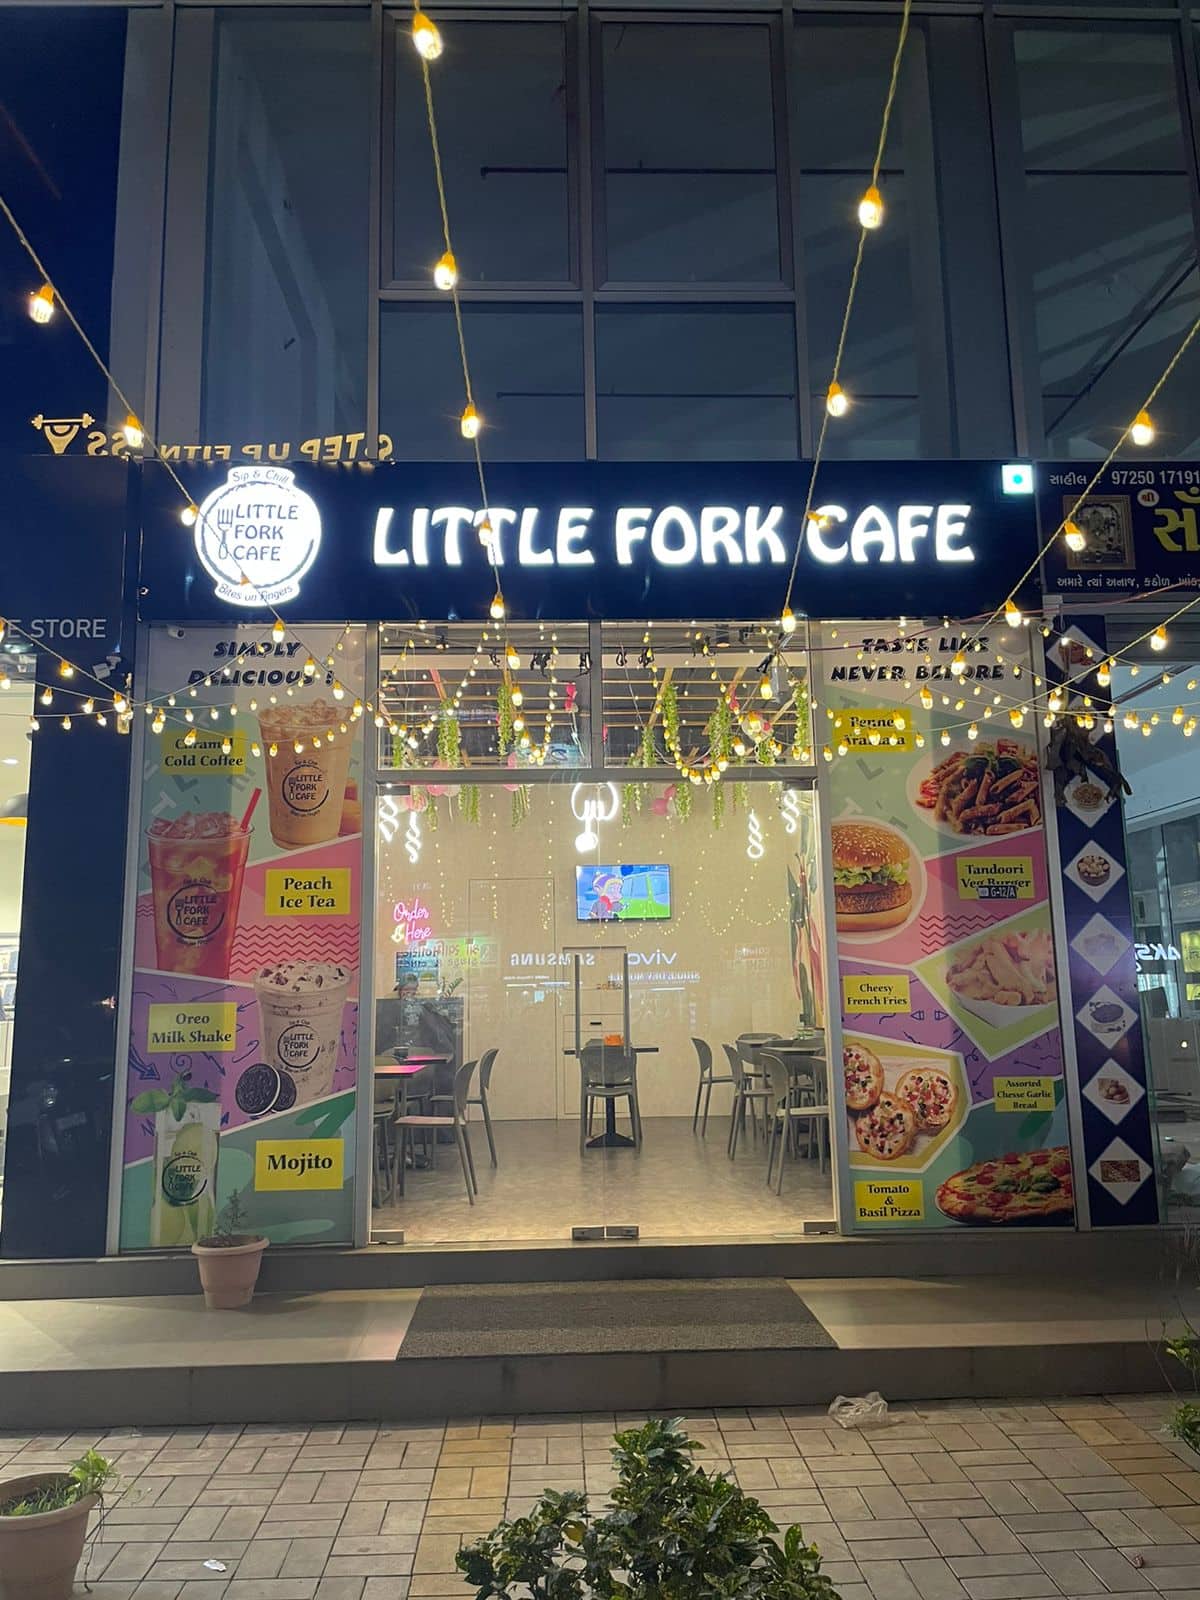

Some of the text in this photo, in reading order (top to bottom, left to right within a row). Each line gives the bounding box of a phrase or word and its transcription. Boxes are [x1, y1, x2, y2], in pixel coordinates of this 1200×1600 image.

[232, 469, 290, 484] Sip & Chill
[1111, 470, 1154, 485] 97250
[236, 503, 299, 520] LITTLE
[234, 524, 284, 540] FORK
[372, 504, 976, 566] LITTLE FORK CAFE
[233, 545, 281, 562] CAFE
[30, 618, 107, 639] STORE
[213, 641, 302, 658] SIMPLY
[861, 636, 989, 653] TASTE LIKE
[831, 665, 906, 682] NEVER
[165, 754, 244, 767] Cold Coffee
[965, 863, 1025, 875] Tandoori
[283, 876, 332, 891] Peach
[987, 878, 1032, 889] Burger
[279, 895, 337, 908] Ice Tea
[393, 898, 430, 922] Order
[404, 920, 432, 944] Here
[859, 983, 894, 995] Cheesy
[847, 995, 908, 1005] French Fries
[176, 1013, 210, 1025] Oreo
[151, 1029, 232, 1044] Milk Shake
[1006, 1079, 1042, 1088] Assorted
[1026, 1089, 1053, 1098] Garlic
[1013, 1100, 1038, 1109] Bread
[267, 1153, 334, 1177] Mojito
[867, 1183, 910, 1194] Tomato
[884, 1195, 894, 1206] &
[859, 1206, 921, 1217] Basil Pizza
